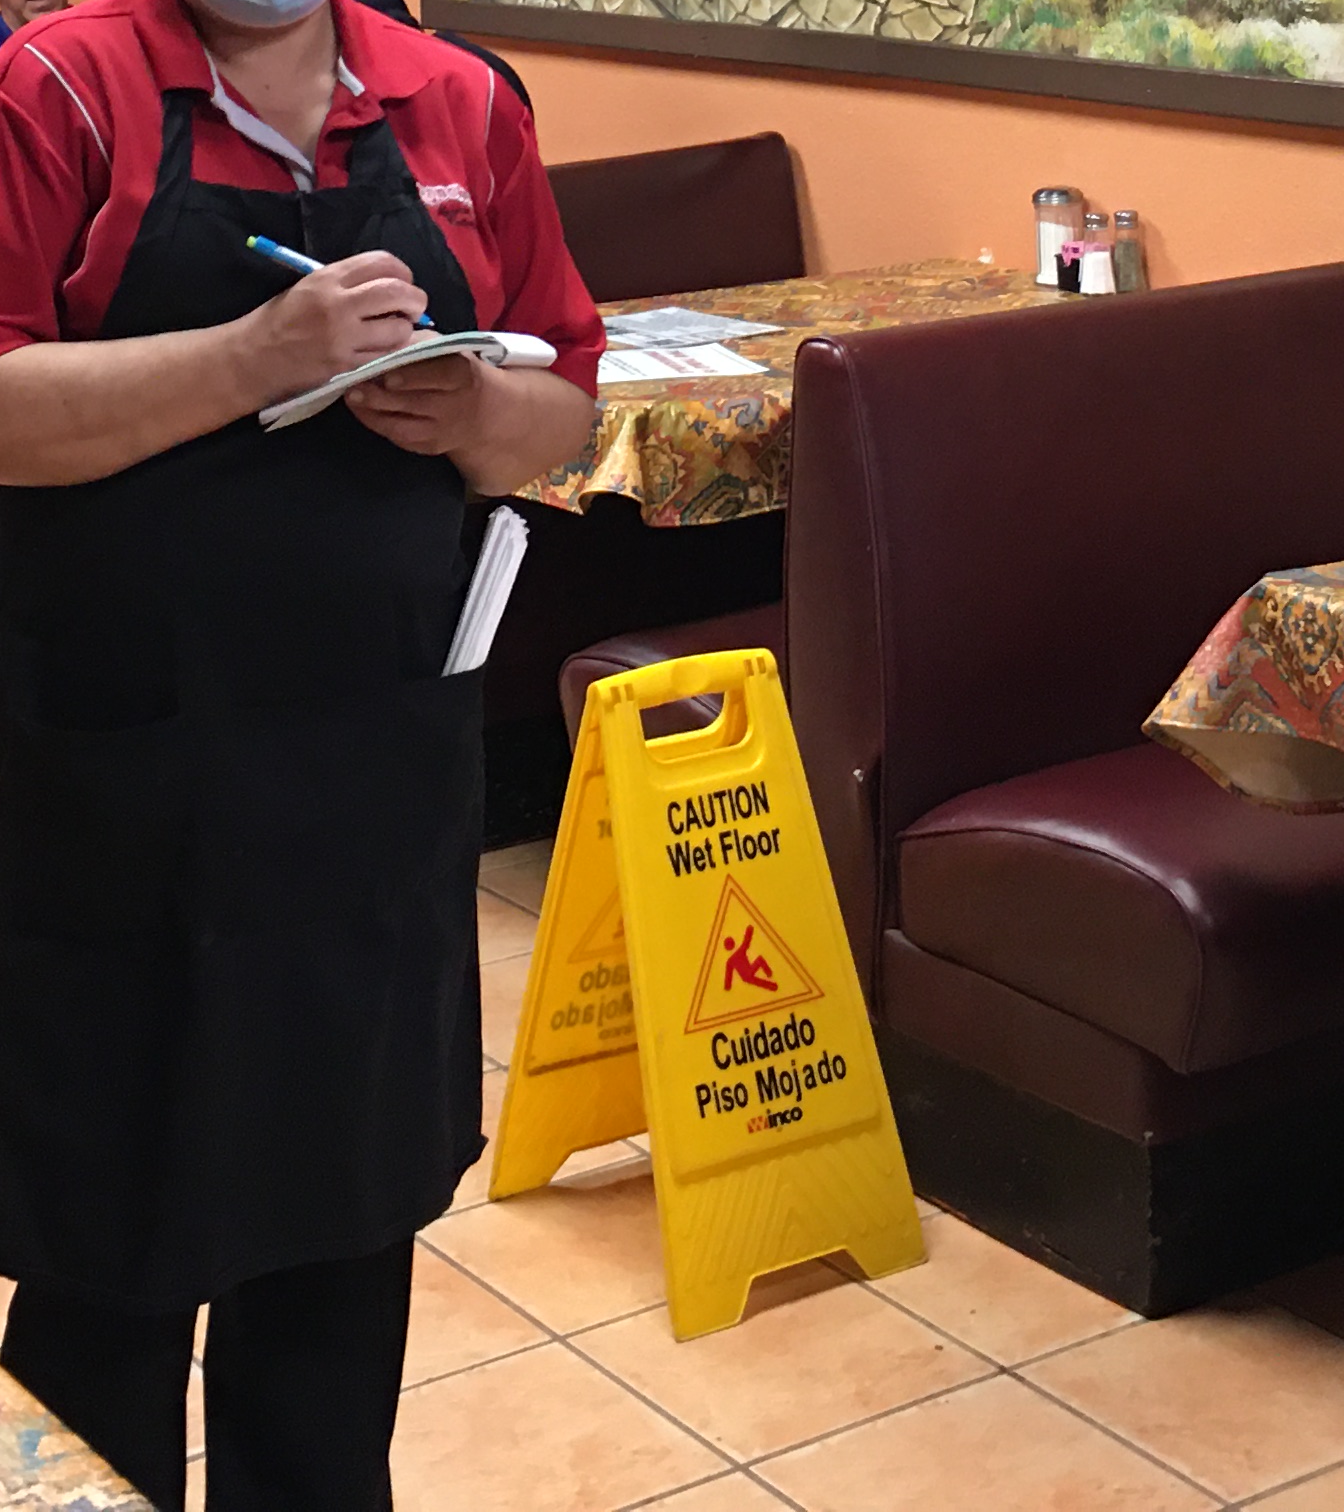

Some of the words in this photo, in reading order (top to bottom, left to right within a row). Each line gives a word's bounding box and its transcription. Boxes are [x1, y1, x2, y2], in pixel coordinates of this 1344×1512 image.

[667, 781, 770, 835] CAUTION
[666, 837, 716, 877] Wet
[719, 827, 780, 865] Floor
[711, 1012, 815, 1070] Cuidado
[695, 1081, 749, 1119] Piso
[755, 1050, 847, 1103] Mojado
